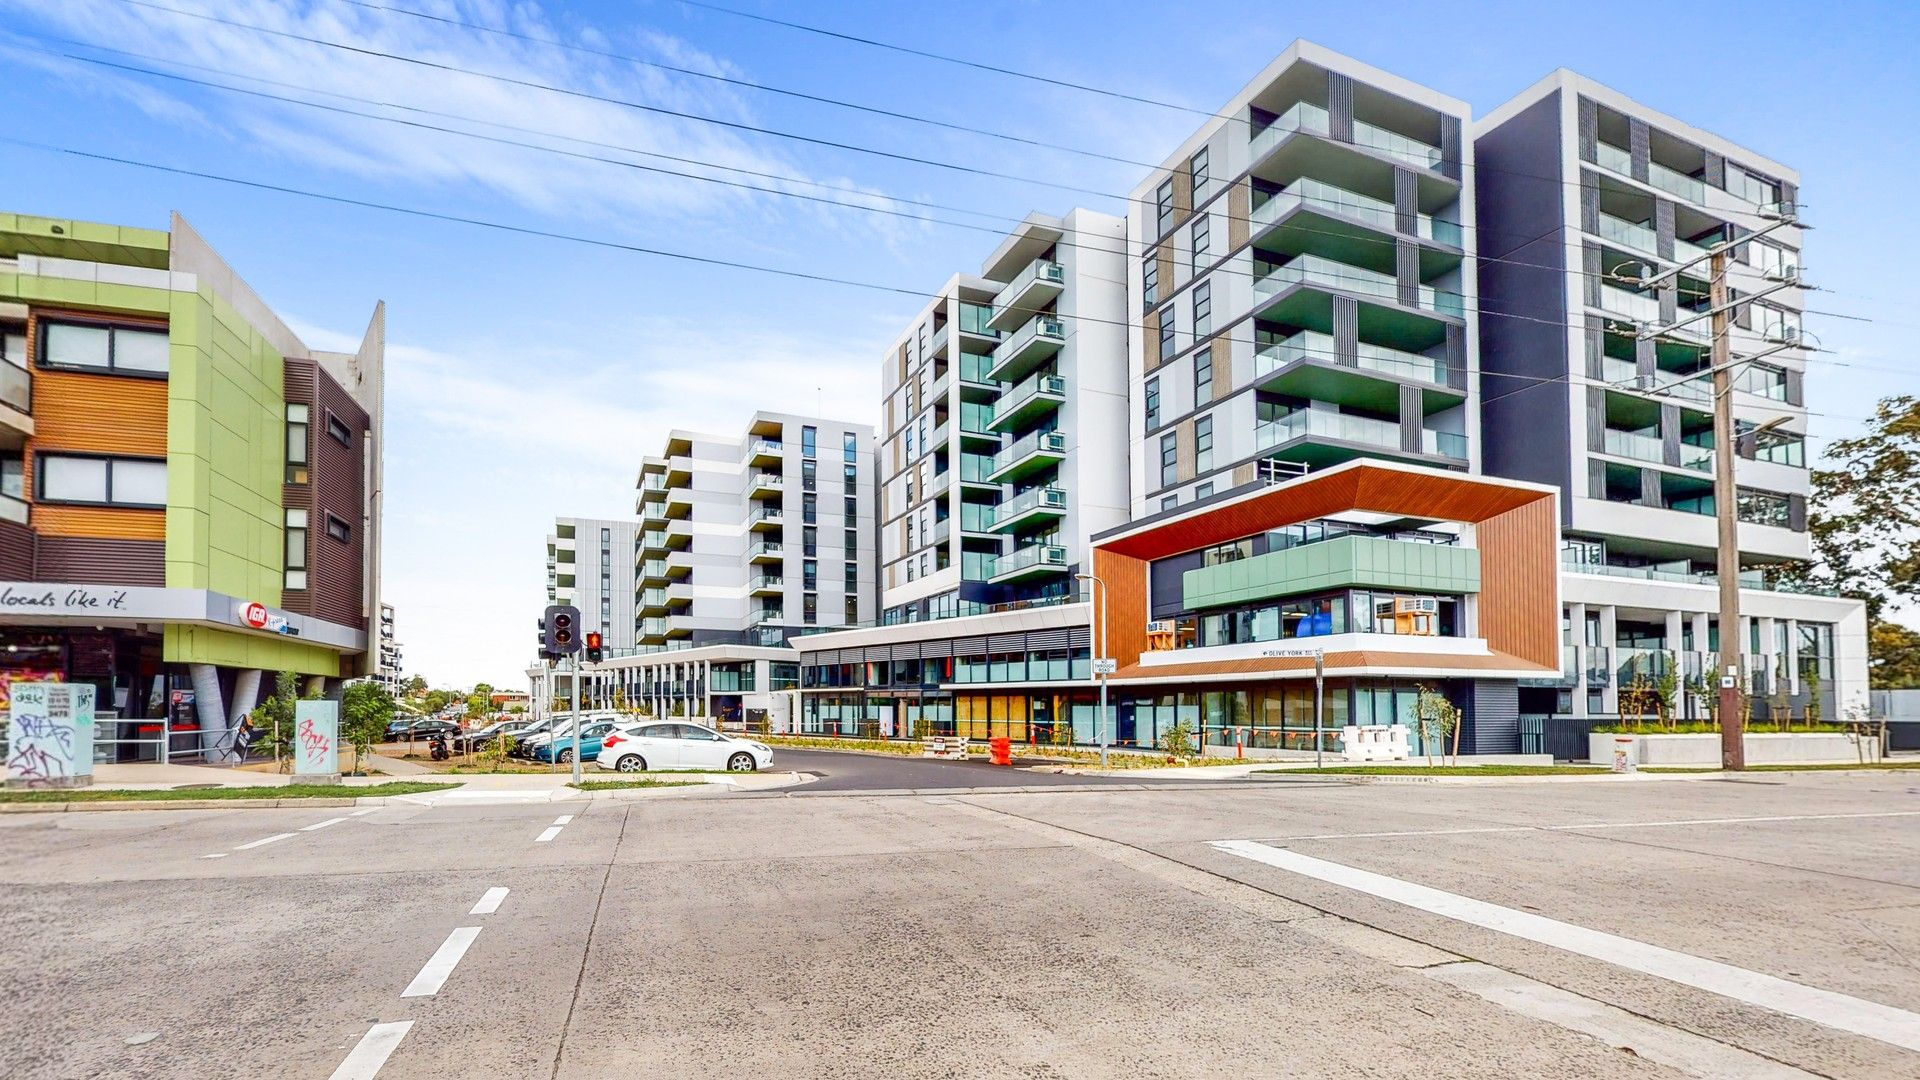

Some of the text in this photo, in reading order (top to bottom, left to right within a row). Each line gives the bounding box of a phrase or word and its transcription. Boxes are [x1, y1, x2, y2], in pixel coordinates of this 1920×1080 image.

[0, 587, 127, 609] locals like it
[249, 606, 266, 624] IGA
